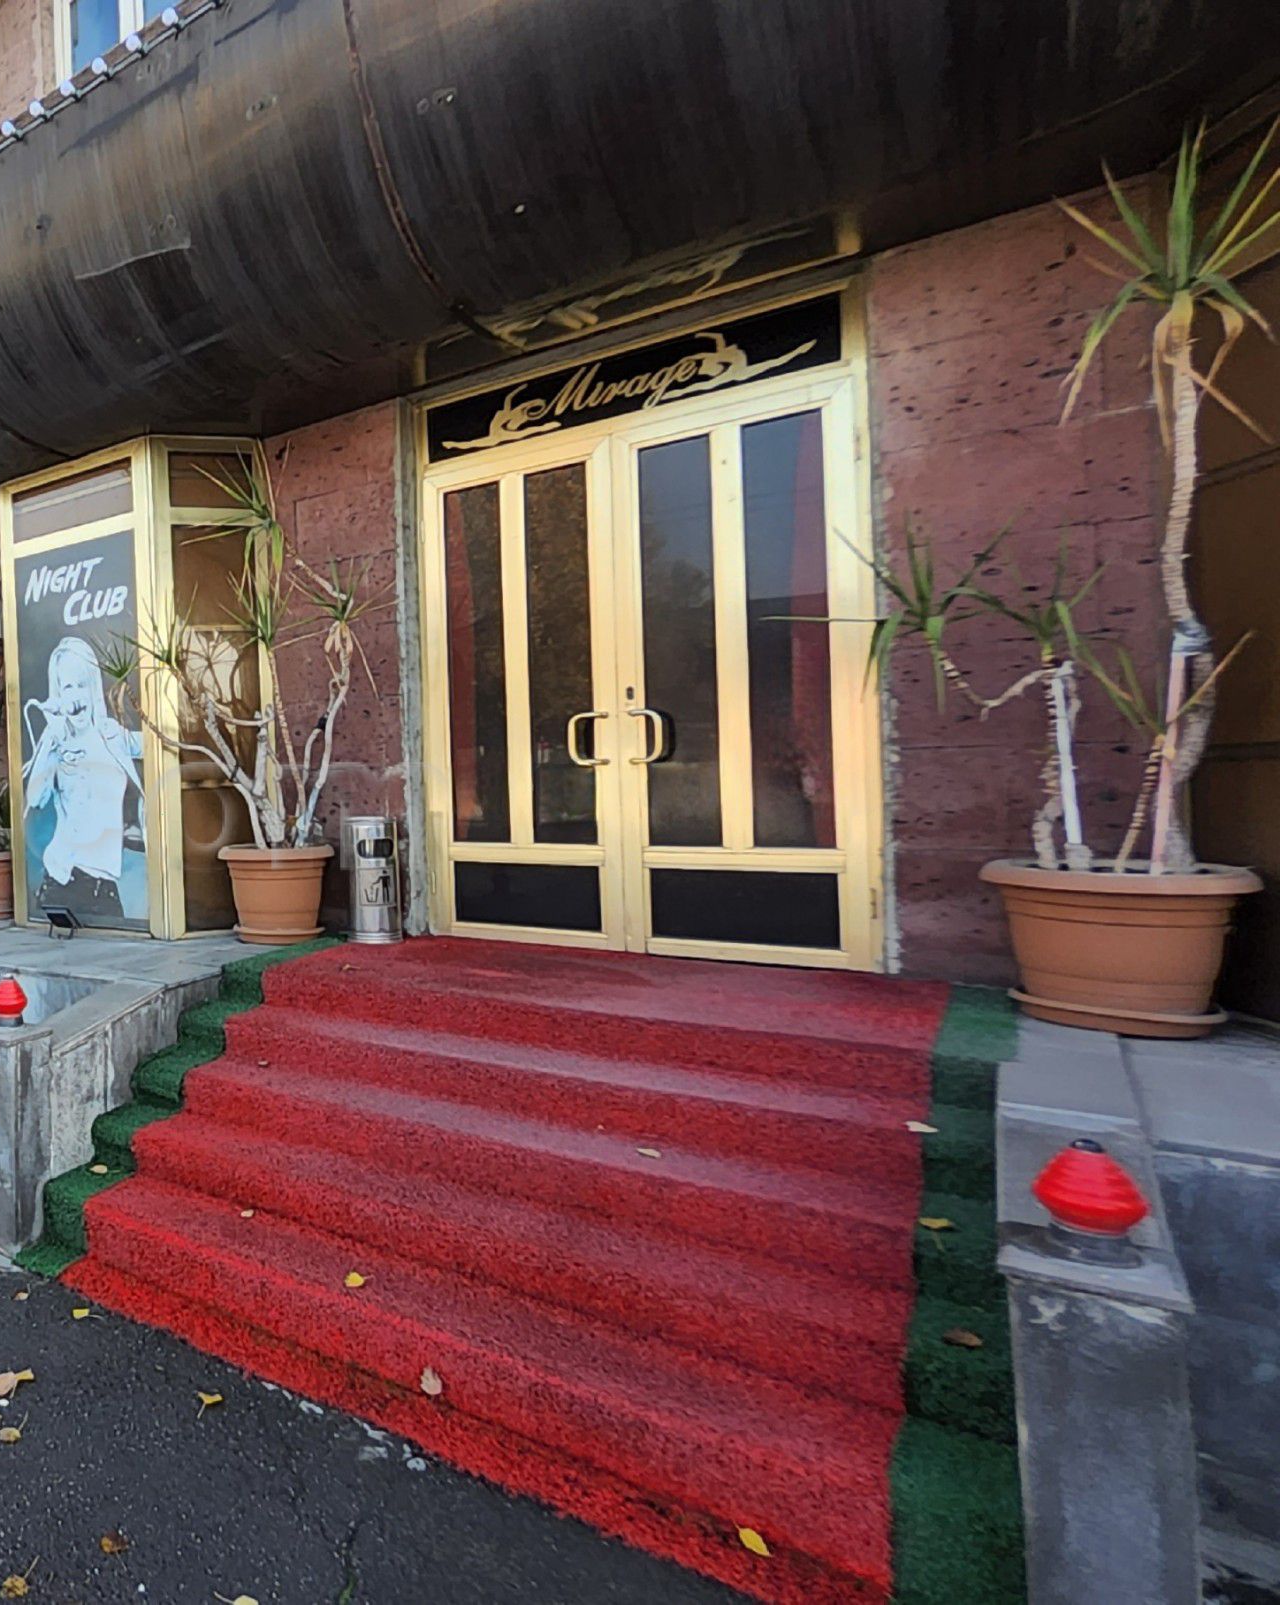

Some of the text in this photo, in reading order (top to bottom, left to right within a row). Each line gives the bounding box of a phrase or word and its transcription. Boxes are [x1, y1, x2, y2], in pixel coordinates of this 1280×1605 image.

[526, 360, 700, 421] Mirage
[24, 557, 104, 606] NIGHT
[63, 585, 128, 626] CLUB
